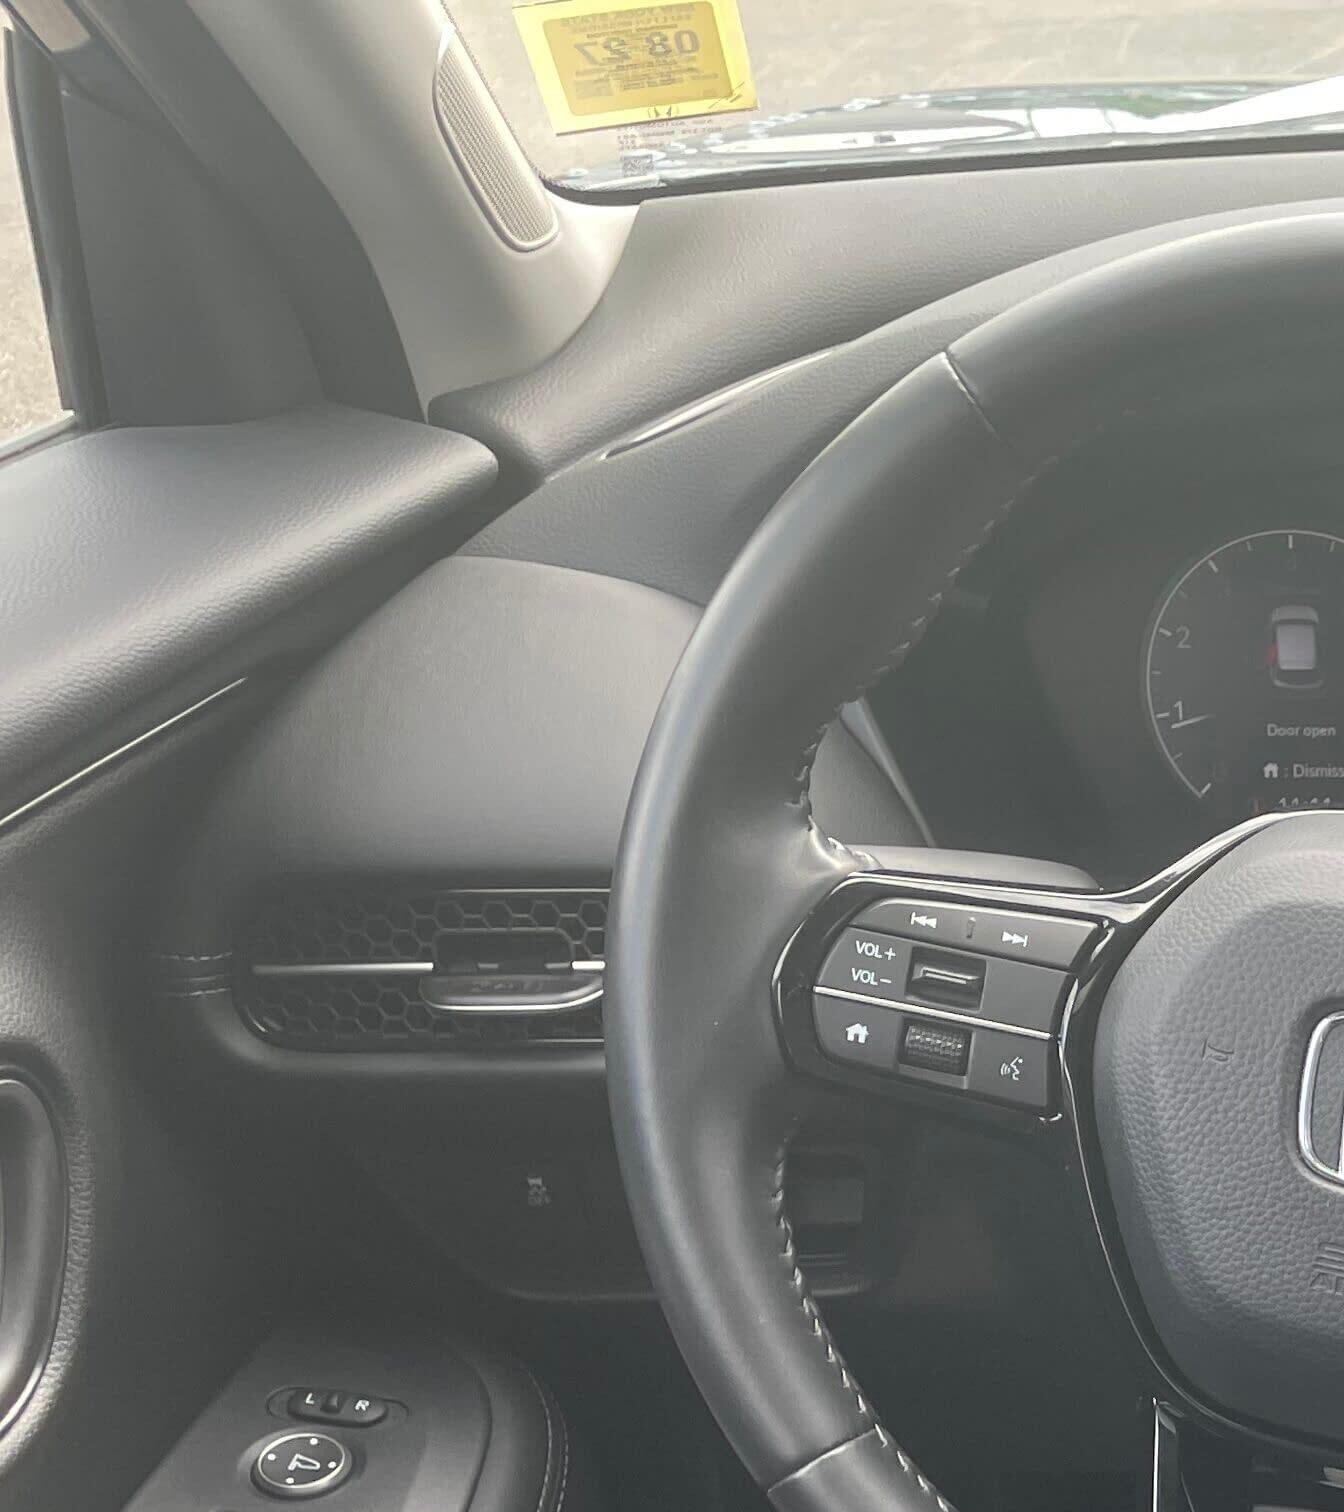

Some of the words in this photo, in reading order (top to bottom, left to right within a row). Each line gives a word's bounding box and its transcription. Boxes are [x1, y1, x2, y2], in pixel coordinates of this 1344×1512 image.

[1175, 625, 1192, 649] 2
[1172, 700, 1184, 721] 1
[1266, 723, 1301, 738] Door
[1303, 725, 1336, 741] open
[305, 1392, 315, 1405] L
[354, 1399, 370, 1412] R
